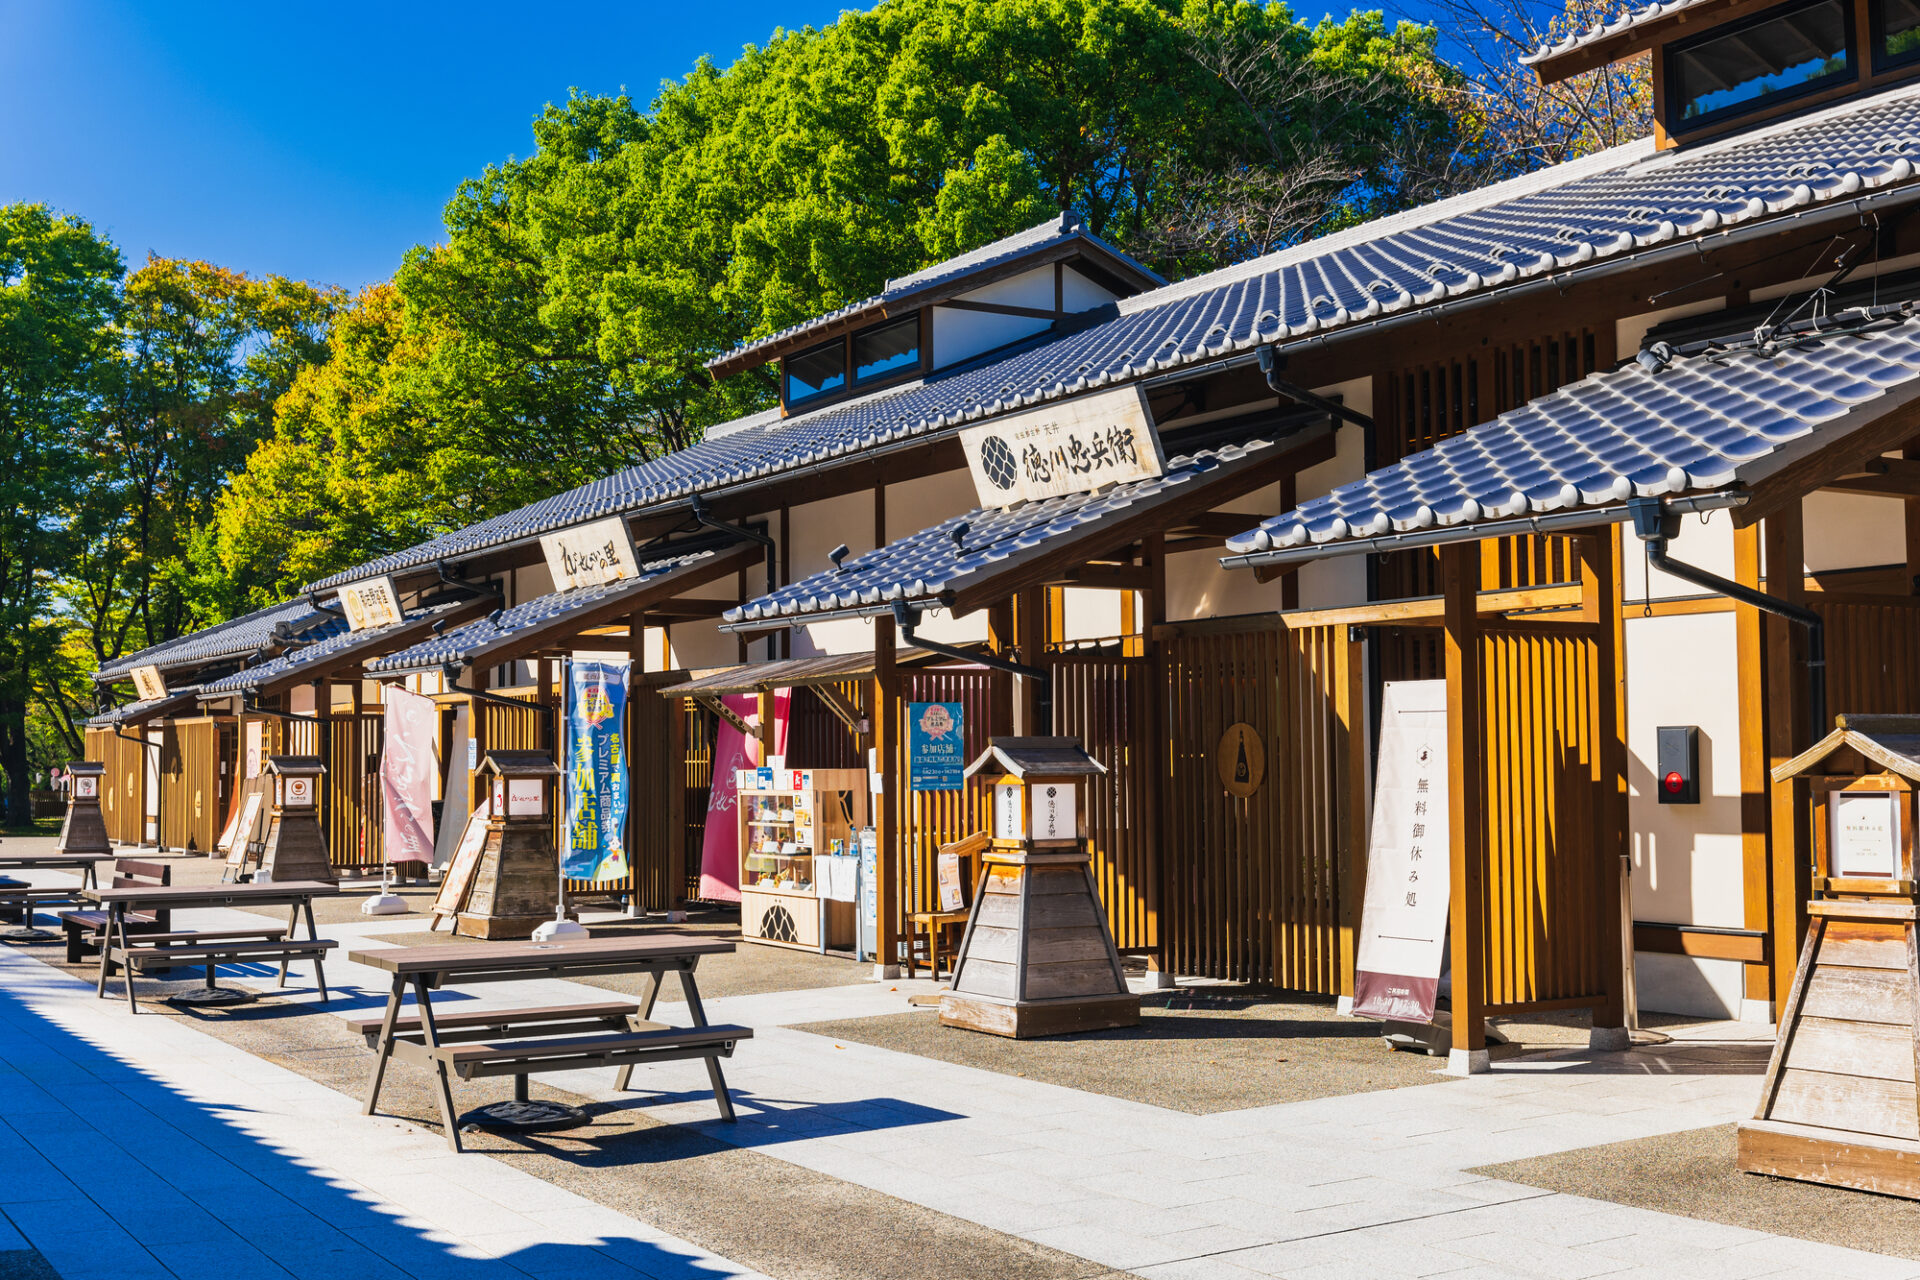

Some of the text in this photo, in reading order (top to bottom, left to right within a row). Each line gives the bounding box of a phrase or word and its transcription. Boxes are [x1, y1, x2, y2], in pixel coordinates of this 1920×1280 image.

[571, 733, 599, 851] 参加店舗
[1405, 777, 1430, 908] 無料御休み処
